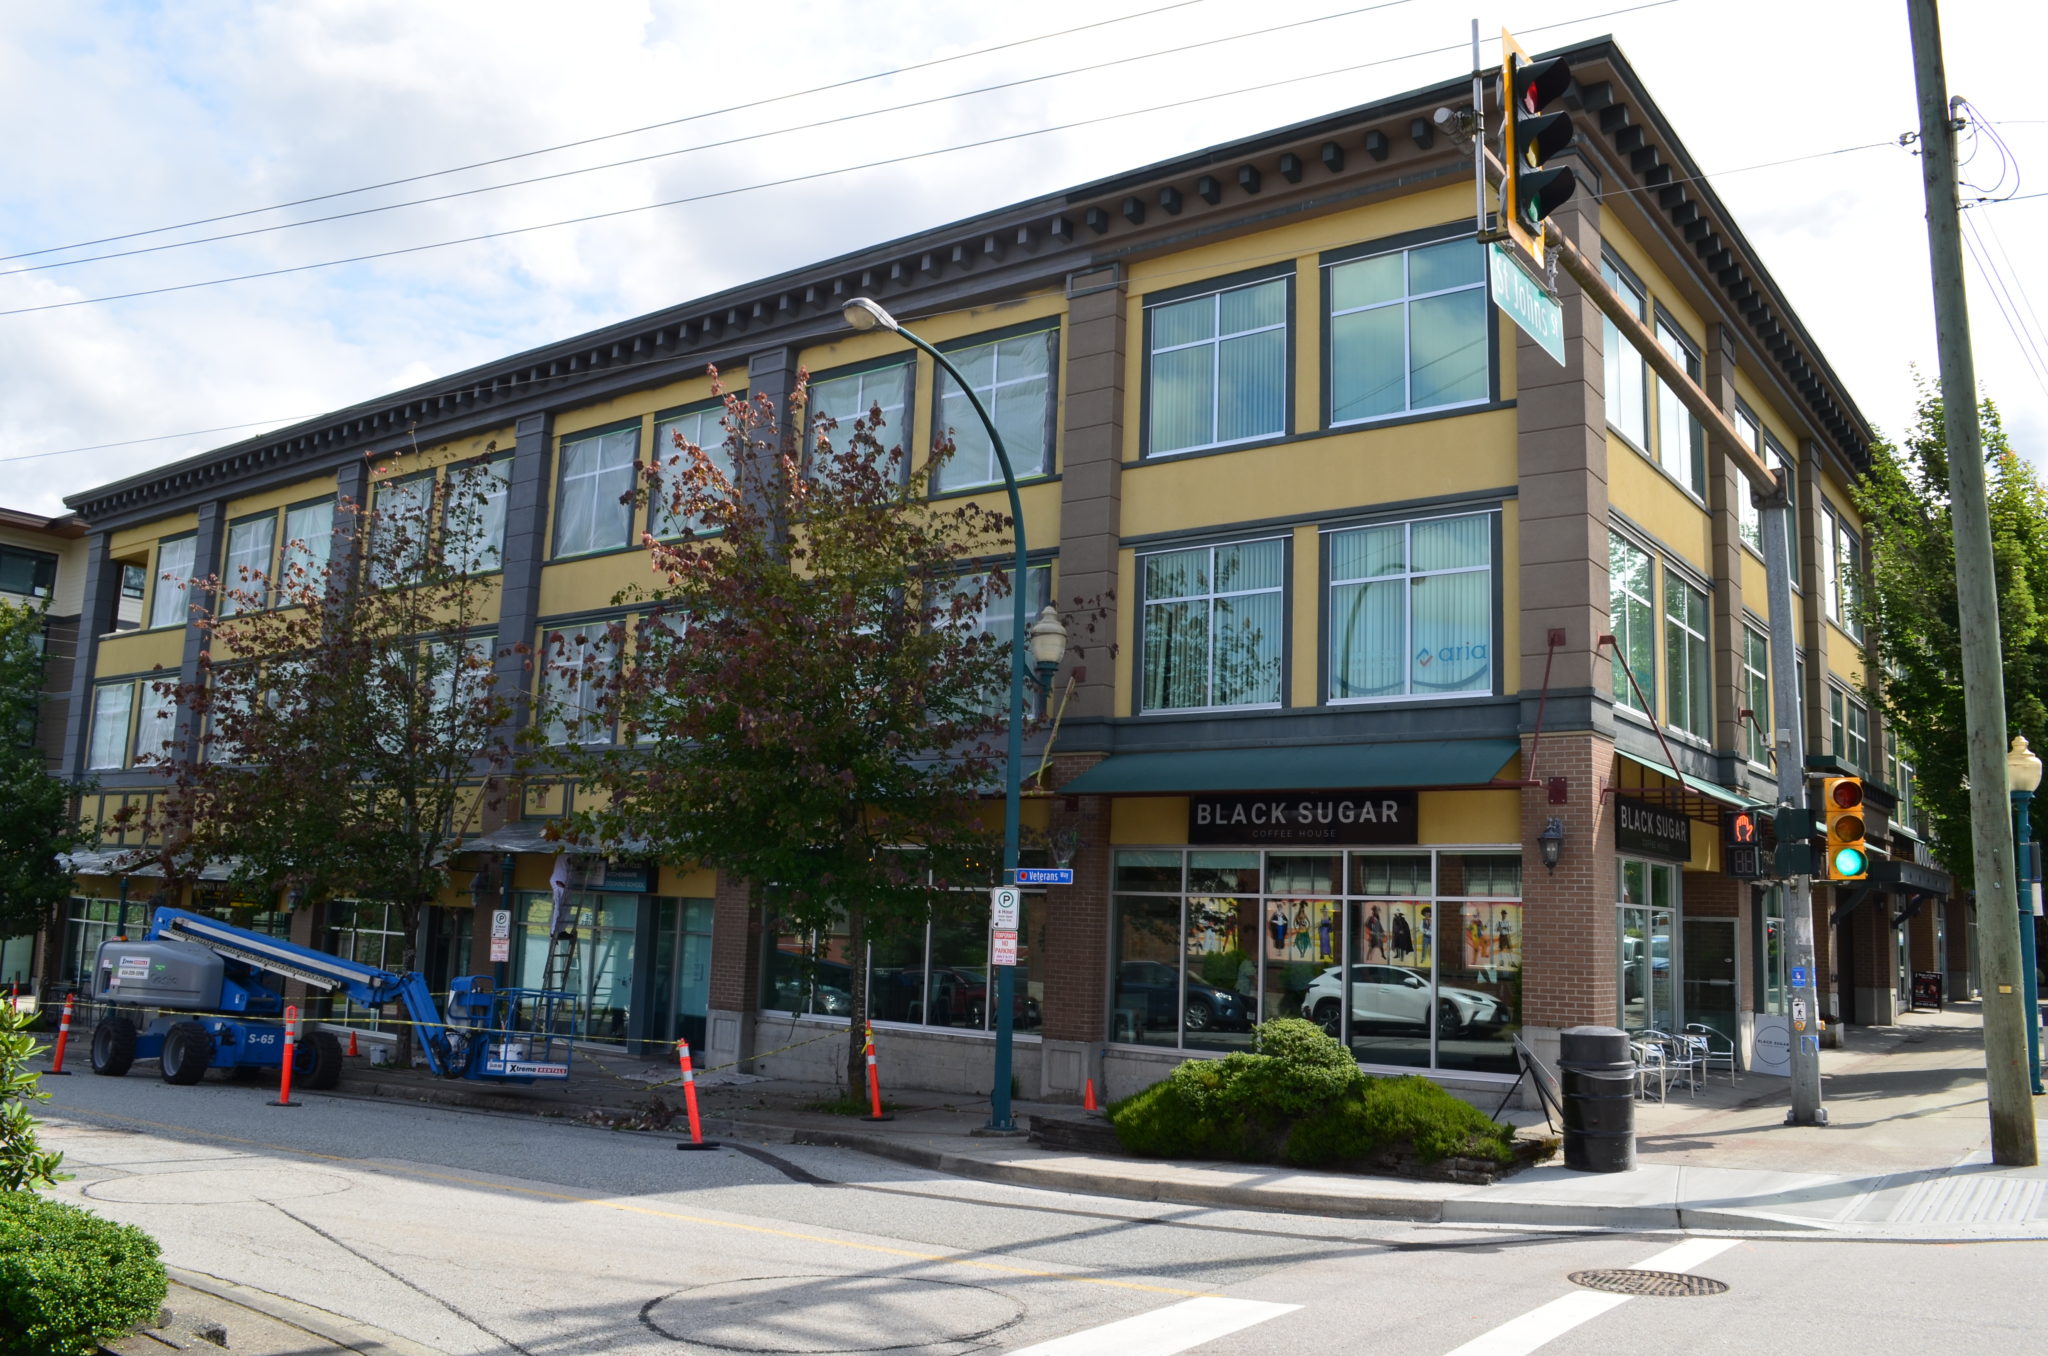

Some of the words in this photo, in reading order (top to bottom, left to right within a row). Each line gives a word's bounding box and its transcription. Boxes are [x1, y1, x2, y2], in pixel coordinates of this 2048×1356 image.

[1496, 255, 1510, 302] St
[1513, 273, 1548, 337] Johns
[1439, 641, 1487, 662] aria
[1197, 802, 1287, 825] BLACK
[1297, 800, 1399, 824] SUGAR
[1620, 804, 1654, 835] BLACK
[1656, 814, 1687, 841] SUGAR
[1252, 829, 1293, 838] COFFEE
[1299, 829, 1337, 838] HOUSE
[1029, 871, 1058, 881] Veterans
[1060, 871, 1069, 880] Way
[248, 1034, 275, 1045] S-65
[509, 1064, 537, 1073] Xtreme
